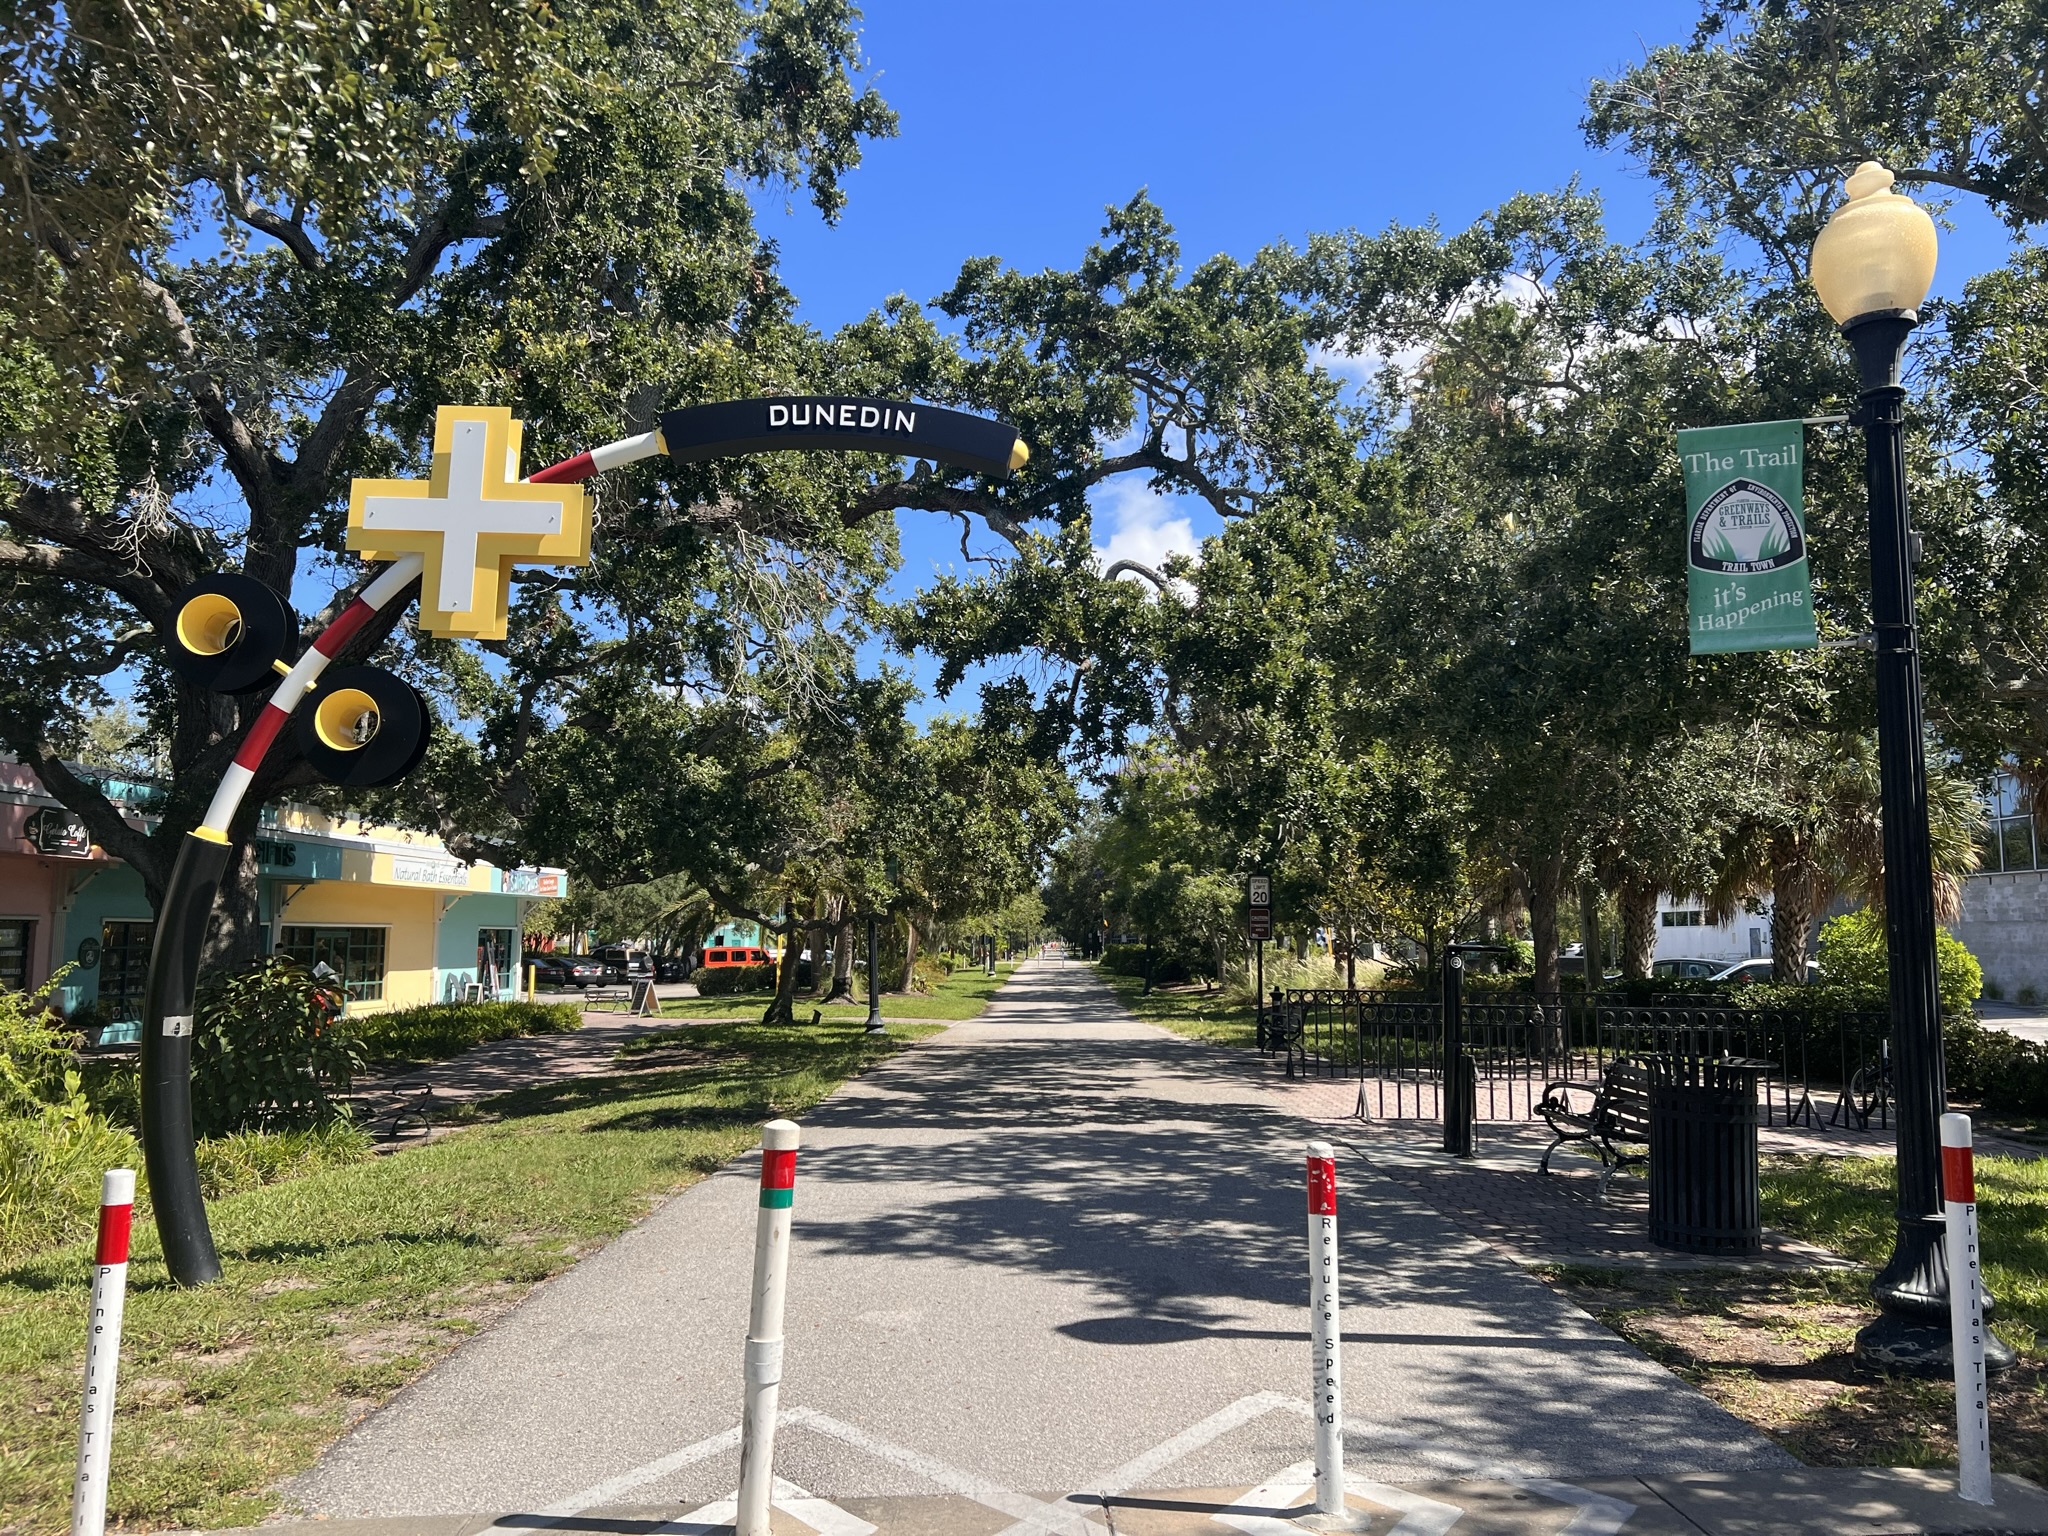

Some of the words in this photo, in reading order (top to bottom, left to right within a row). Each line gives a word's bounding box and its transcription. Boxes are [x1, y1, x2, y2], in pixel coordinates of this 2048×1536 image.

[769, 404, 916, 433] DUNEDIN
[1685, 452, 1734, 474] The
[1740, 444, 1798, 469] Trail
[1699, 490, 1729, 521] DEPARTMENT
[1719, 503, 1770, 516] GREENWAYS
[1719, 516, 1727, 528] &
[1731, 513, 1771, 526] TRAILS
[1722, 561, 1748, 572] TRAIL
[1750, 558, 1775, 570] TOWN
[1713, 582, 1747, 608] it's
[1698, 590, 1803, 631] Happening
[394, 867, 422, 881] Natural
[422, 869, 438, 883] Bath
[438, 871, 468, 885] Essentials
[1253, 891, 1267, 903] 20
[1321, 1217, 1332, 1321] Reduce
[87, 1267, 111, 1414] Pinellas
[1966, 1205, 1980, 1345] Pinellas
[1973, 1361, 1985, 1452] Trail
[1324, 1338, 1334, 1425] Speed
[79, 1432, 95, 1527] Trail
